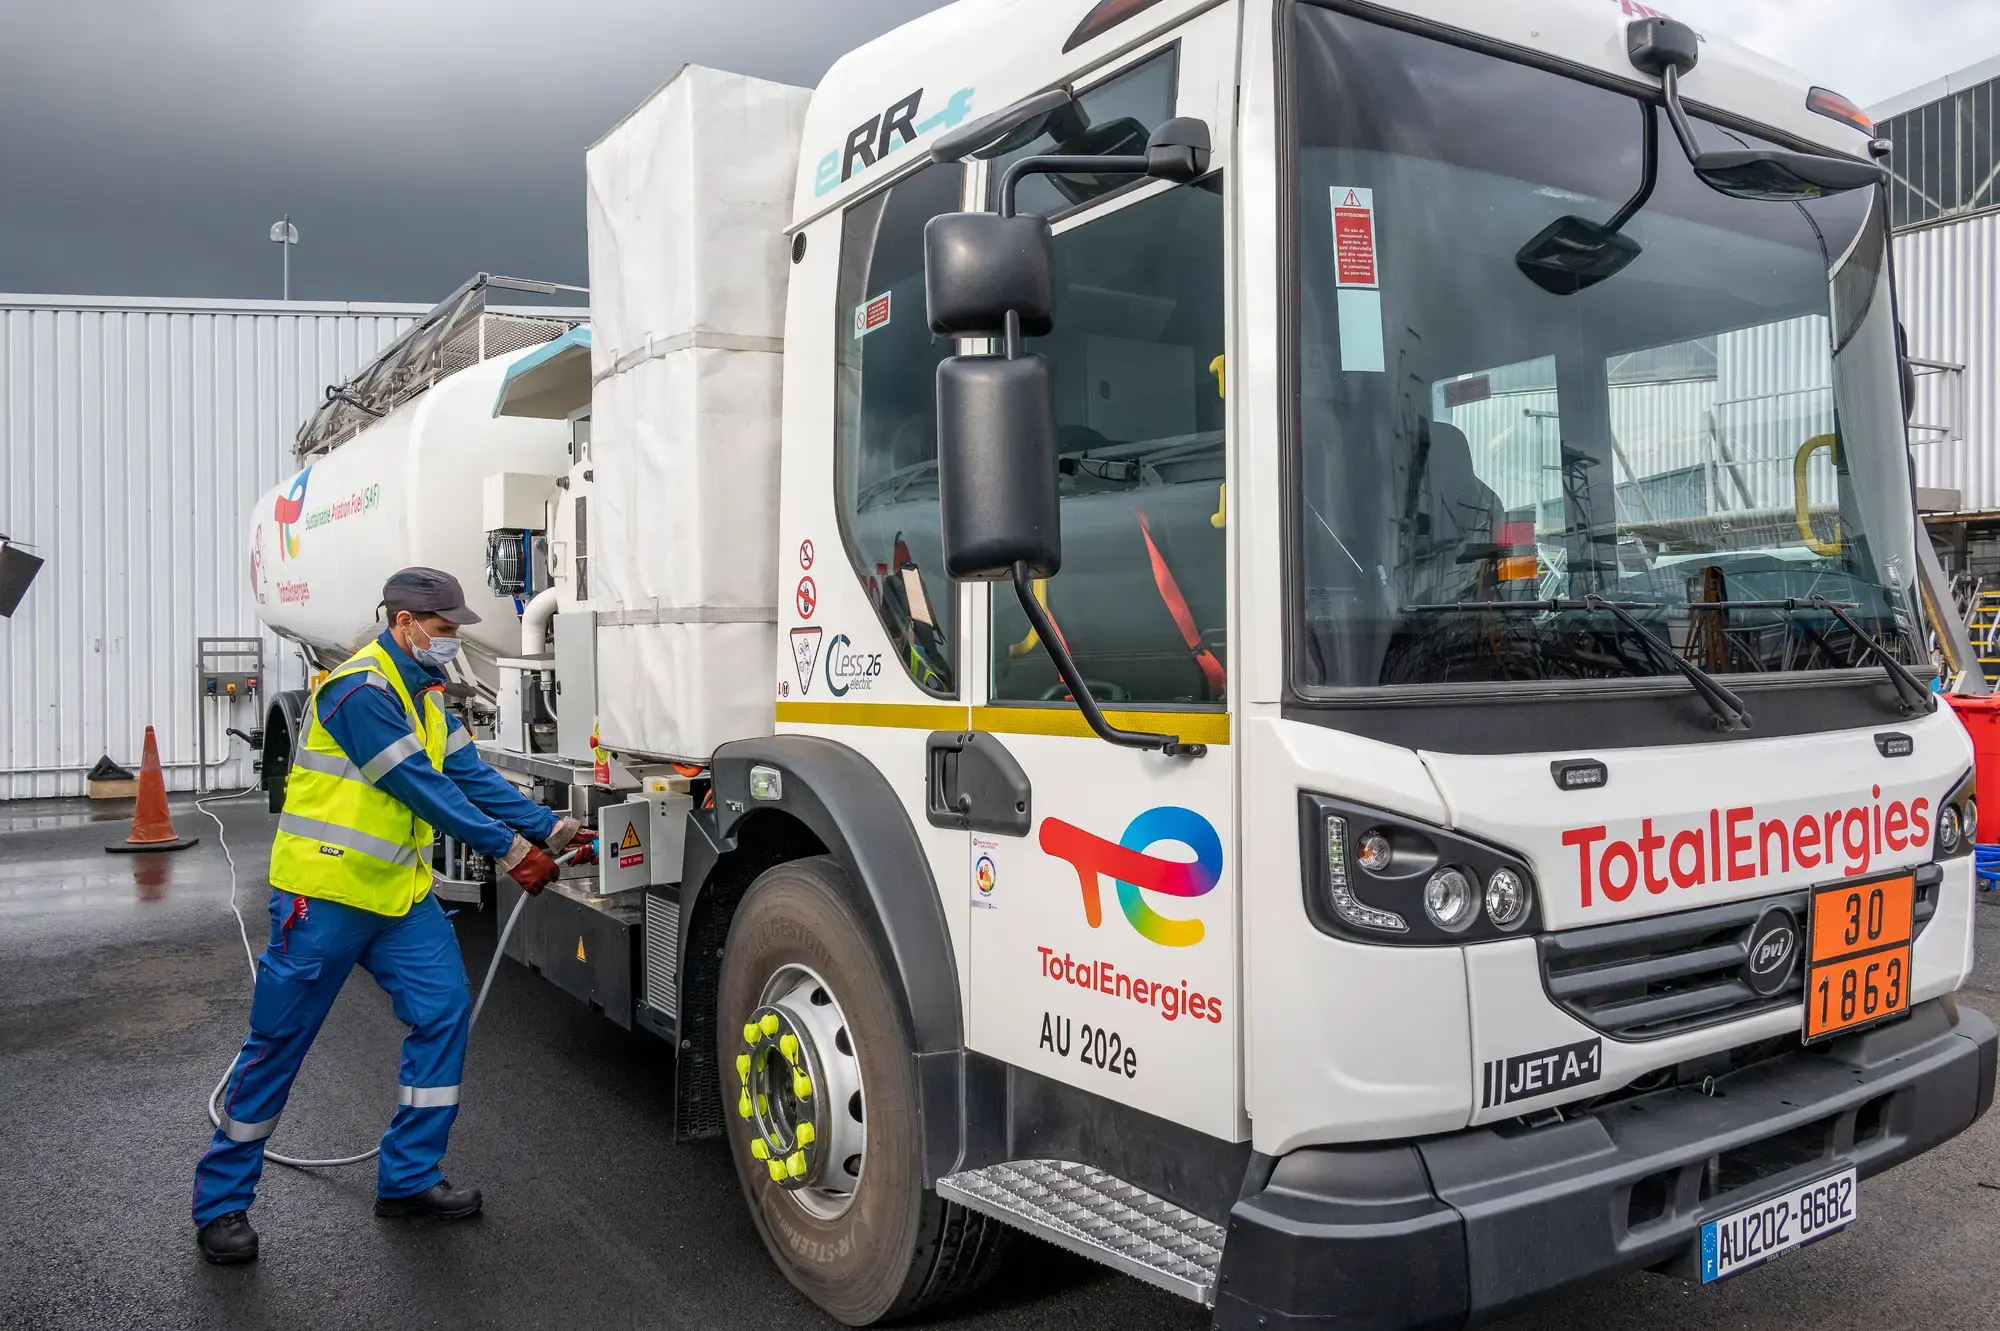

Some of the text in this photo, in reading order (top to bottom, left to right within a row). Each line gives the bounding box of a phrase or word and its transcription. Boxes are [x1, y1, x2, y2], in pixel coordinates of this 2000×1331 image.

[351, 488, 363, 515] Fuel
[850, 678, 873, 690] electric
[1562, 784, 1930, 908] TotalEnergies
[1844, 888, 1884, 946] 30
[1759, 937, 1785, 964] pvi
[1037, 945, 1223, 1024] TotalEnergies
[1818, 957, 1901, 1027] 1863
[1039, 1011, 1137, 1079] AU 202e
[1509, 1044, 1599, 1094] JET A-1
[1719, 1176, 1852, 1270] AU202-8682
[1707, 1259, 1713, 1273] F
